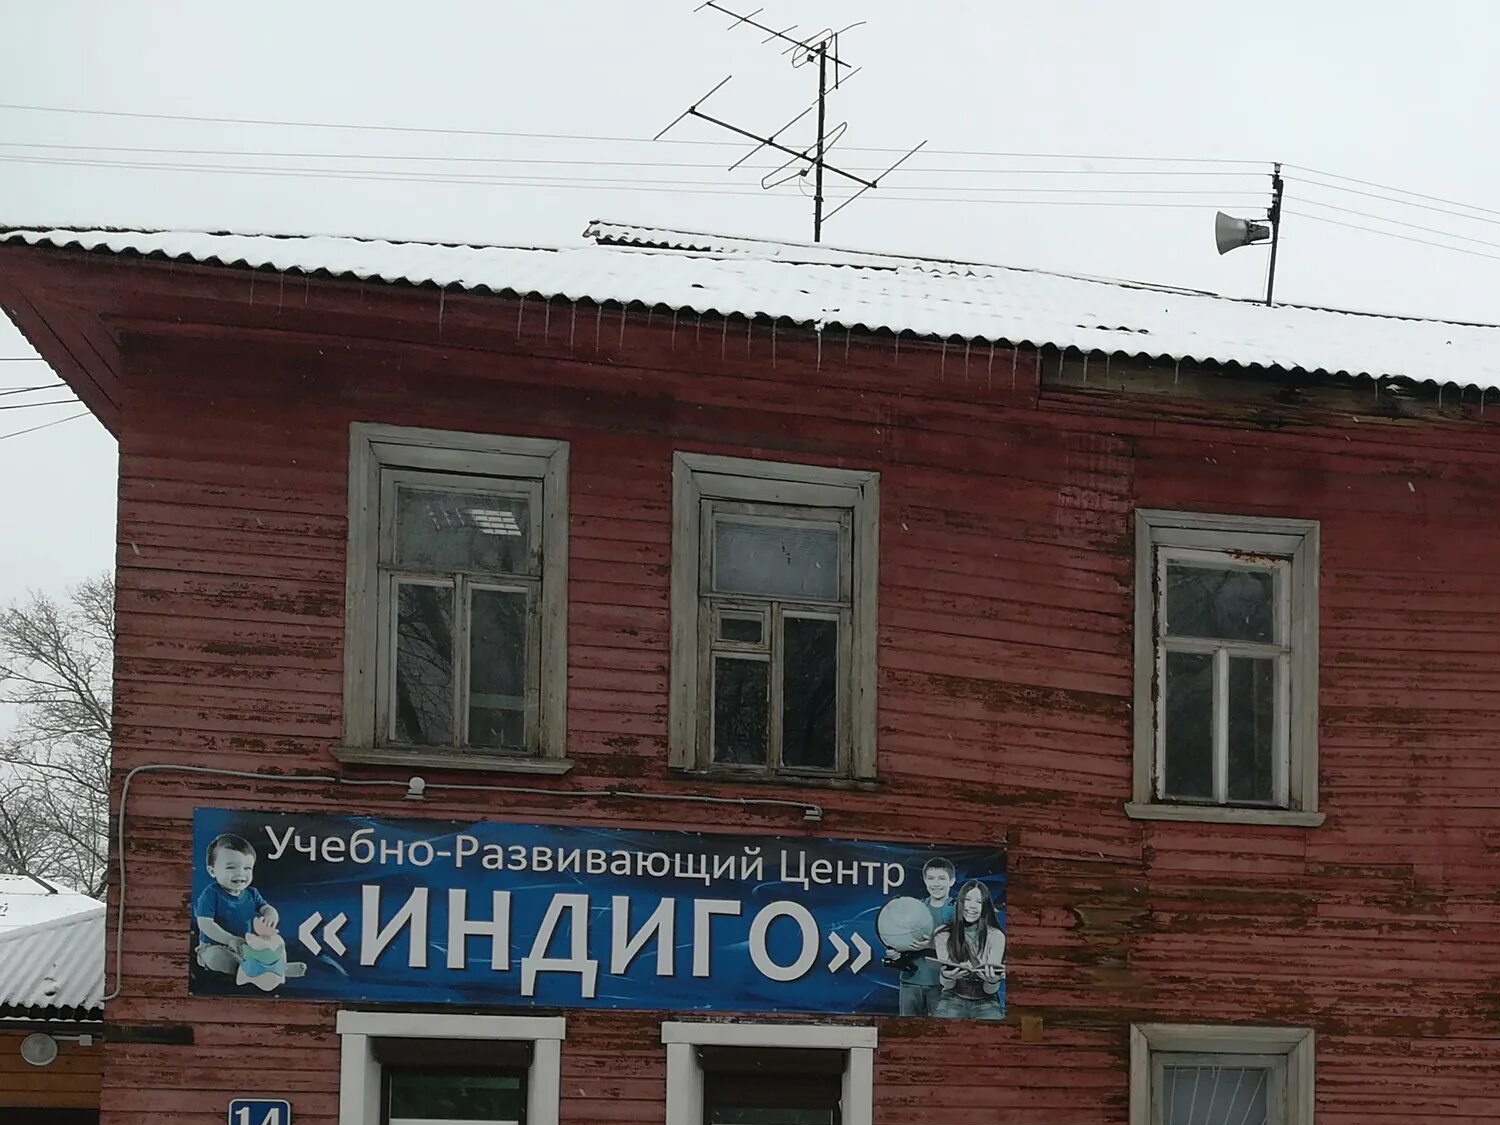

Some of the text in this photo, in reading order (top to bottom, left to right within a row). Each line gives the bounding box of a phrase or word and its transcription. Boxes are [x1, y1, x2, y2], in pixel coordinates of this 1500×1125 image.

[265, 825, 906, 895] Учебно-Развивающий Центр
[298, 884, 872, 997] «ИНДИГО»
